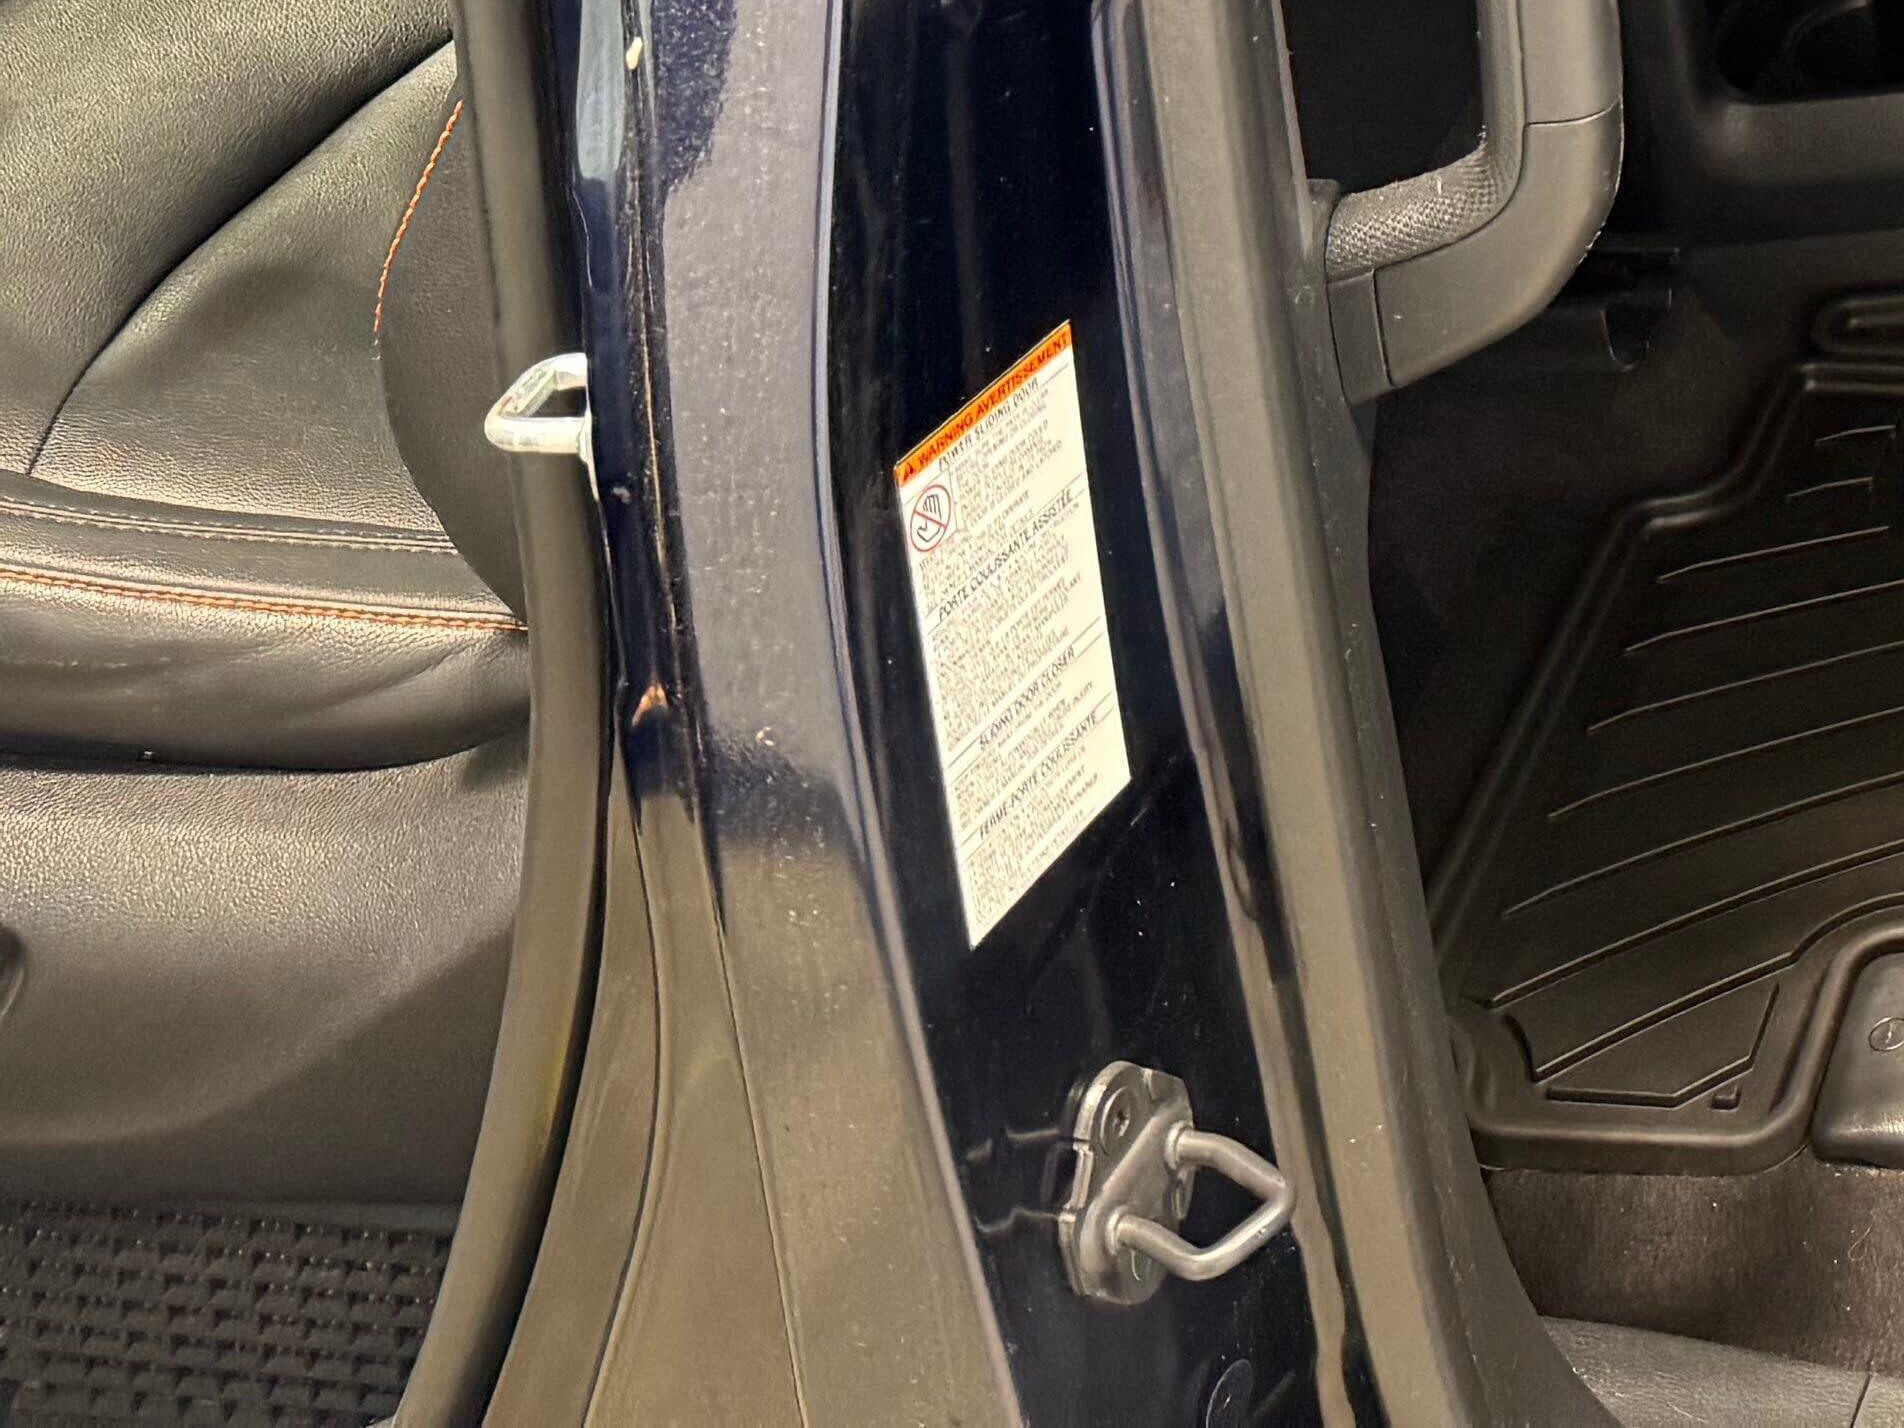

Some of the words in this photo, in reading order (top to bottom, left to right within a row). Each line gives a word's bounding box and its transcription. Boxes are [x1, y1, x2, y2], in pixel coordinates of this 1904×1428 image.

[917, 412, 974, 467] WARNING
[976, 331, 1068, 418] AVERTISSEMENT
[938, 432, 972, 471] POWER
[974, 401, 1011, 441] SLIDING
[1012, 376, 1039, 410] DOOR
[938, 585, 970, 622] PORTE
[969, 528, 1031, 593] COULISSANTE
[978, 705, 1014, 752] SLIDING
[1014, 679, 1040, 717] DOOR
[1040, 645, 1076, 689] CLOSER
